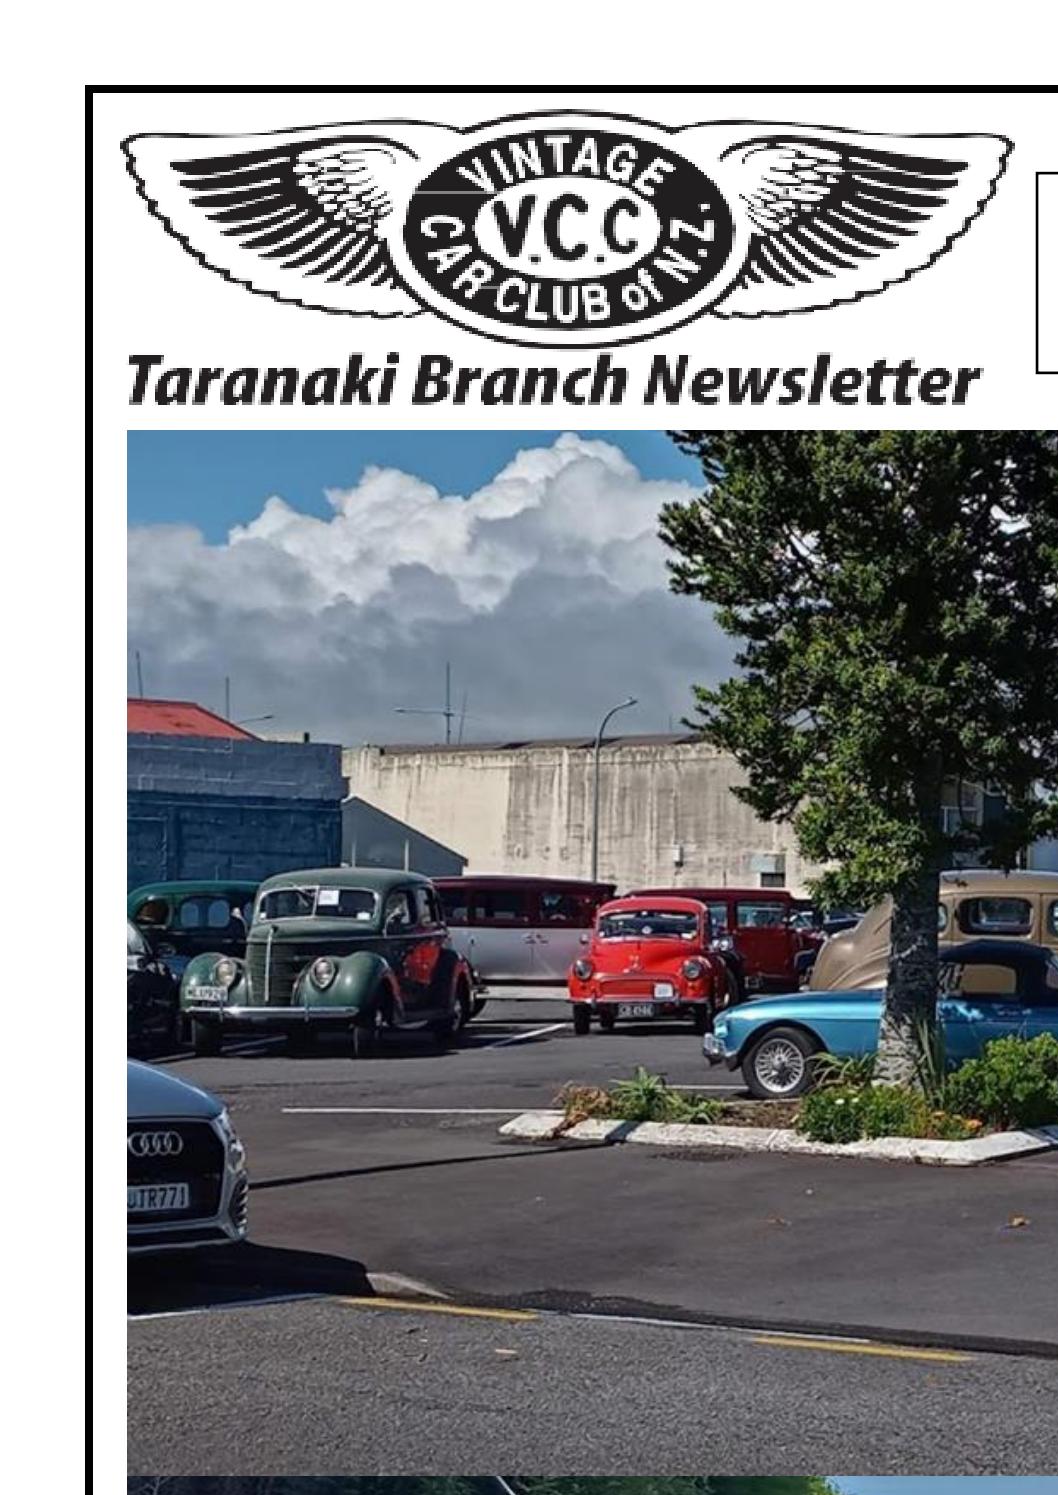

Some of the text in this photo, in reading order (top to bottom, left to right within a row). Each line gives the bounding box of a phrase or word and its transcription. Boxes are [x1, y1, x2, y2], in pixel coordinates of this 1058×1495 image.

[456, 135, 676, 196] VINTAGE
[420, 214, 496, 300] CAR
[495, 277, 611, 323] CLUB
[621, 267, 664, 312] of
[128, 353, 985, 406] Taranaki Branch Newsletter
